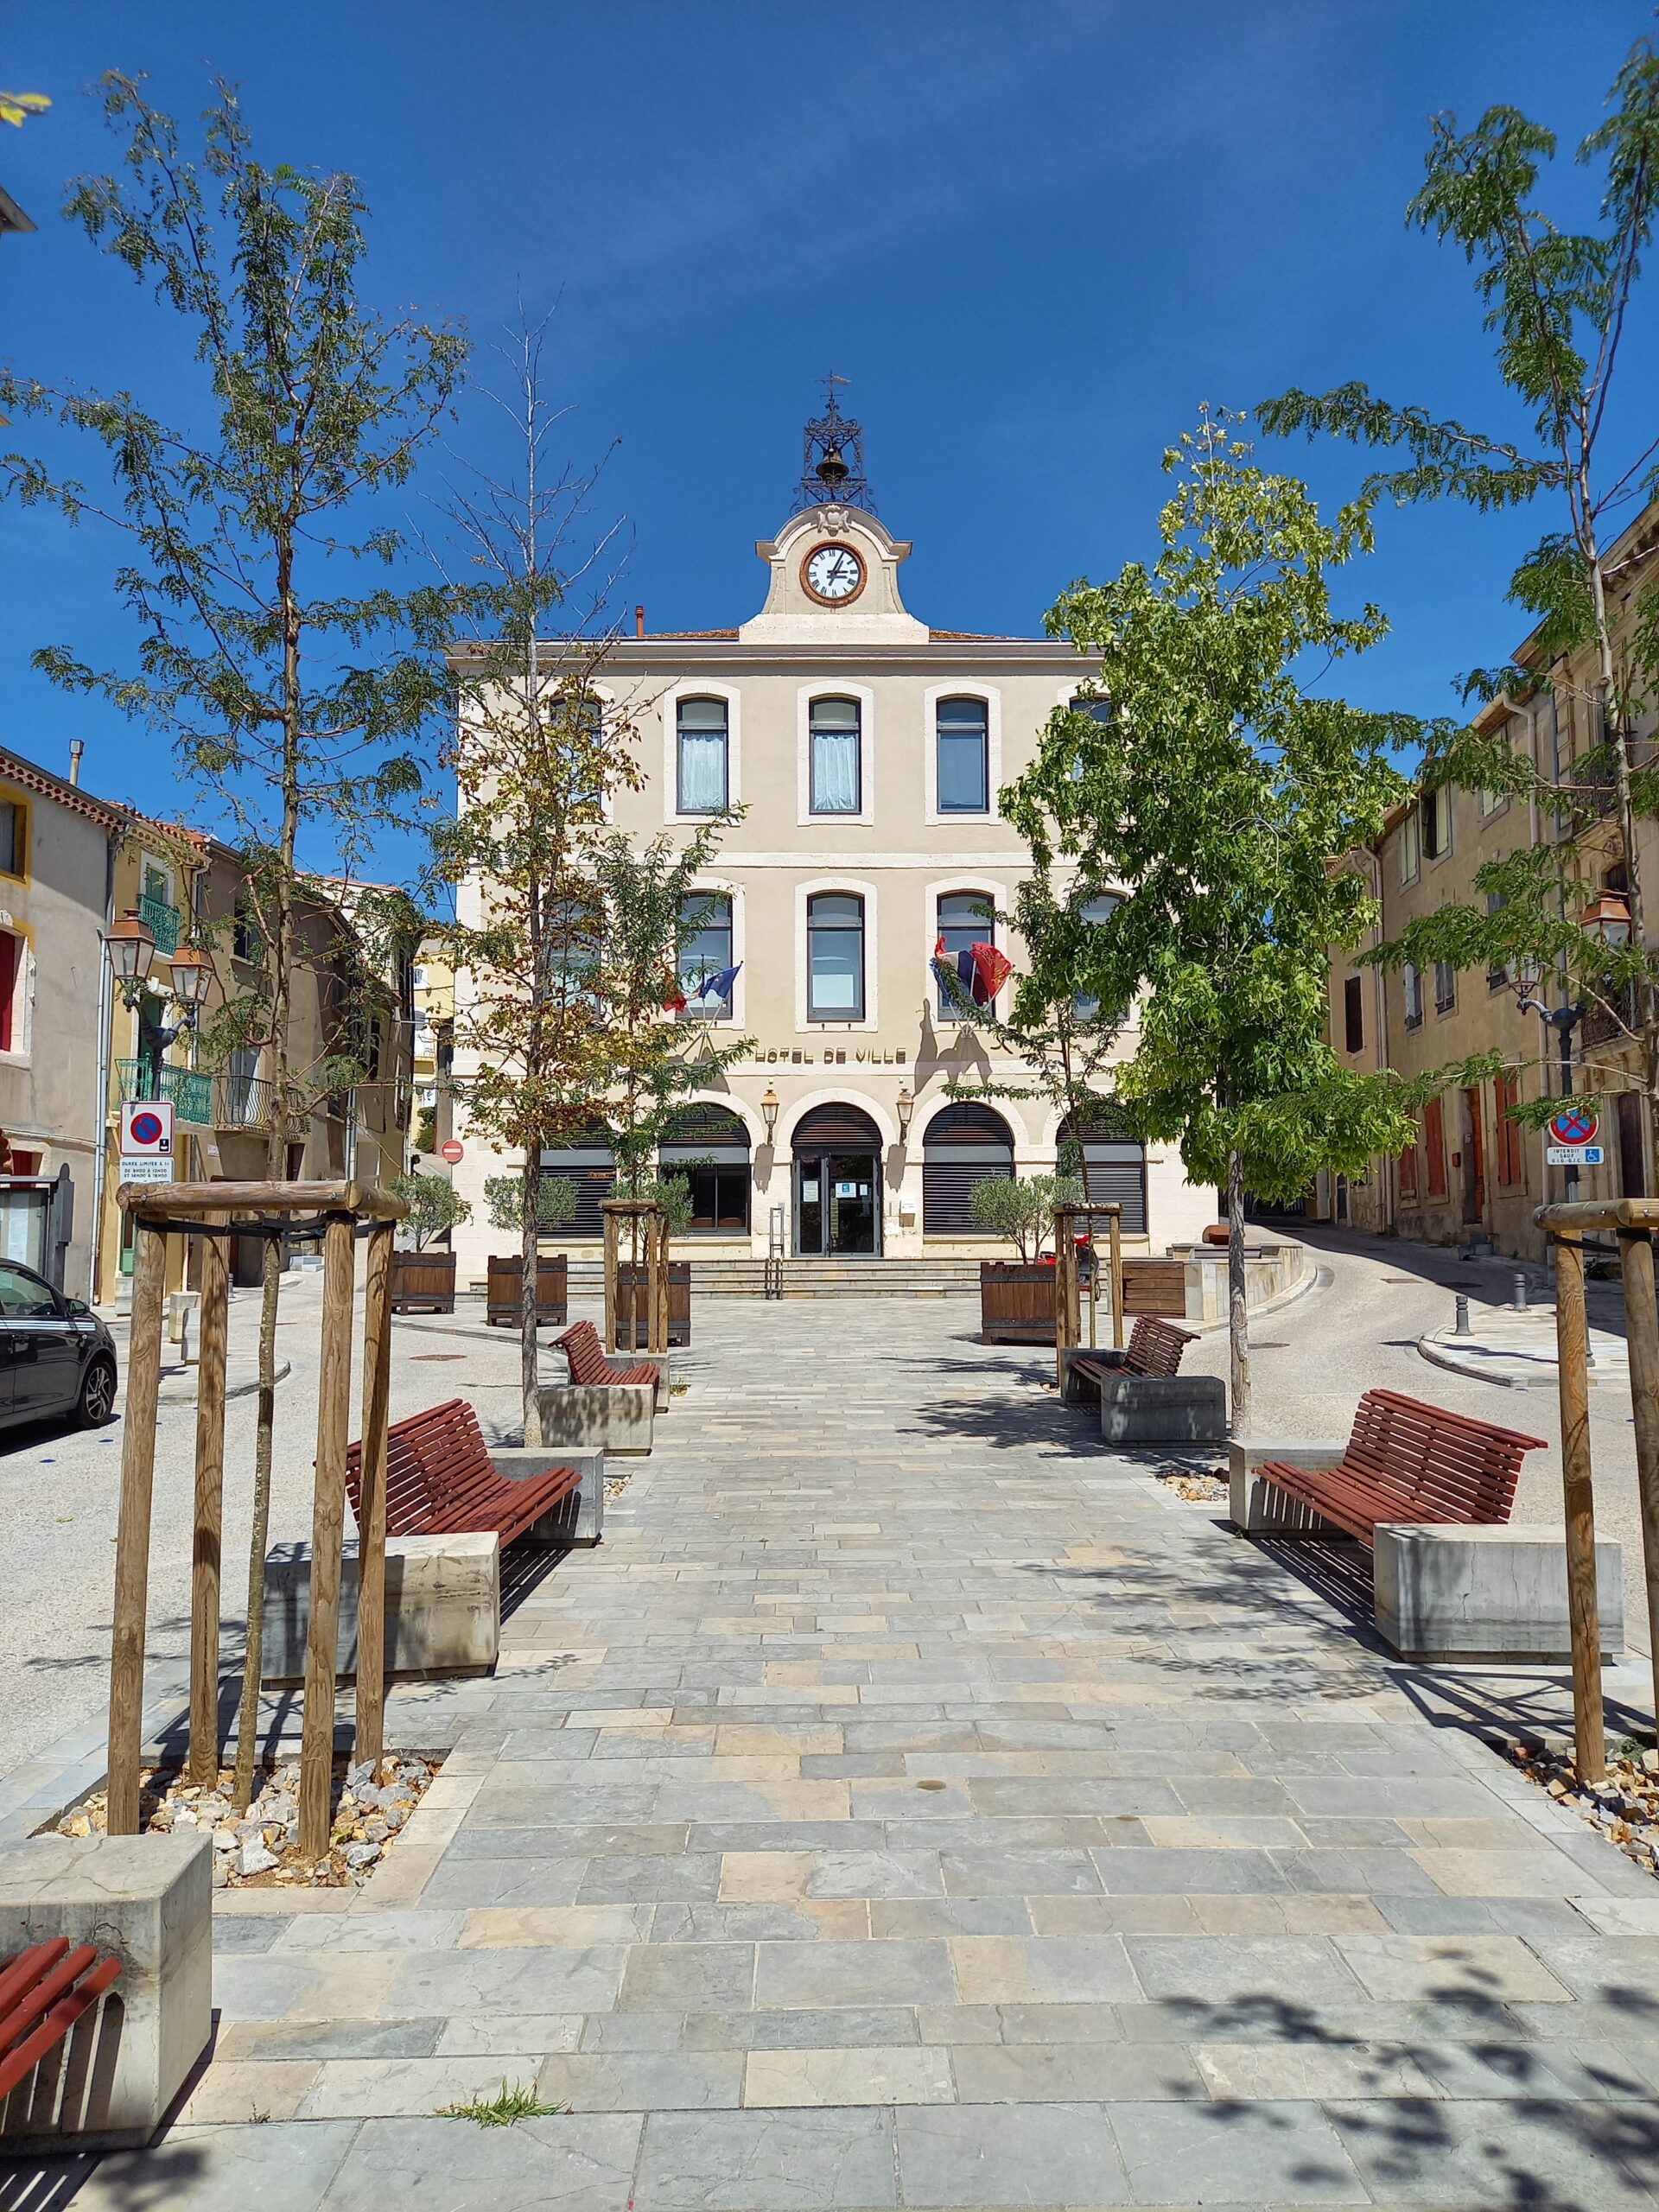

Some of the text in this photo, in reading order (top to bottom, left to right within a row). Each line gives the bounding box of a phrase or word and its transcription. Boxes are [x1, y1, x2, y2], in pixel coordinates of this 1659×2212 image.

[755, 1047, 906, 1065] HOTEL DE VILLE
